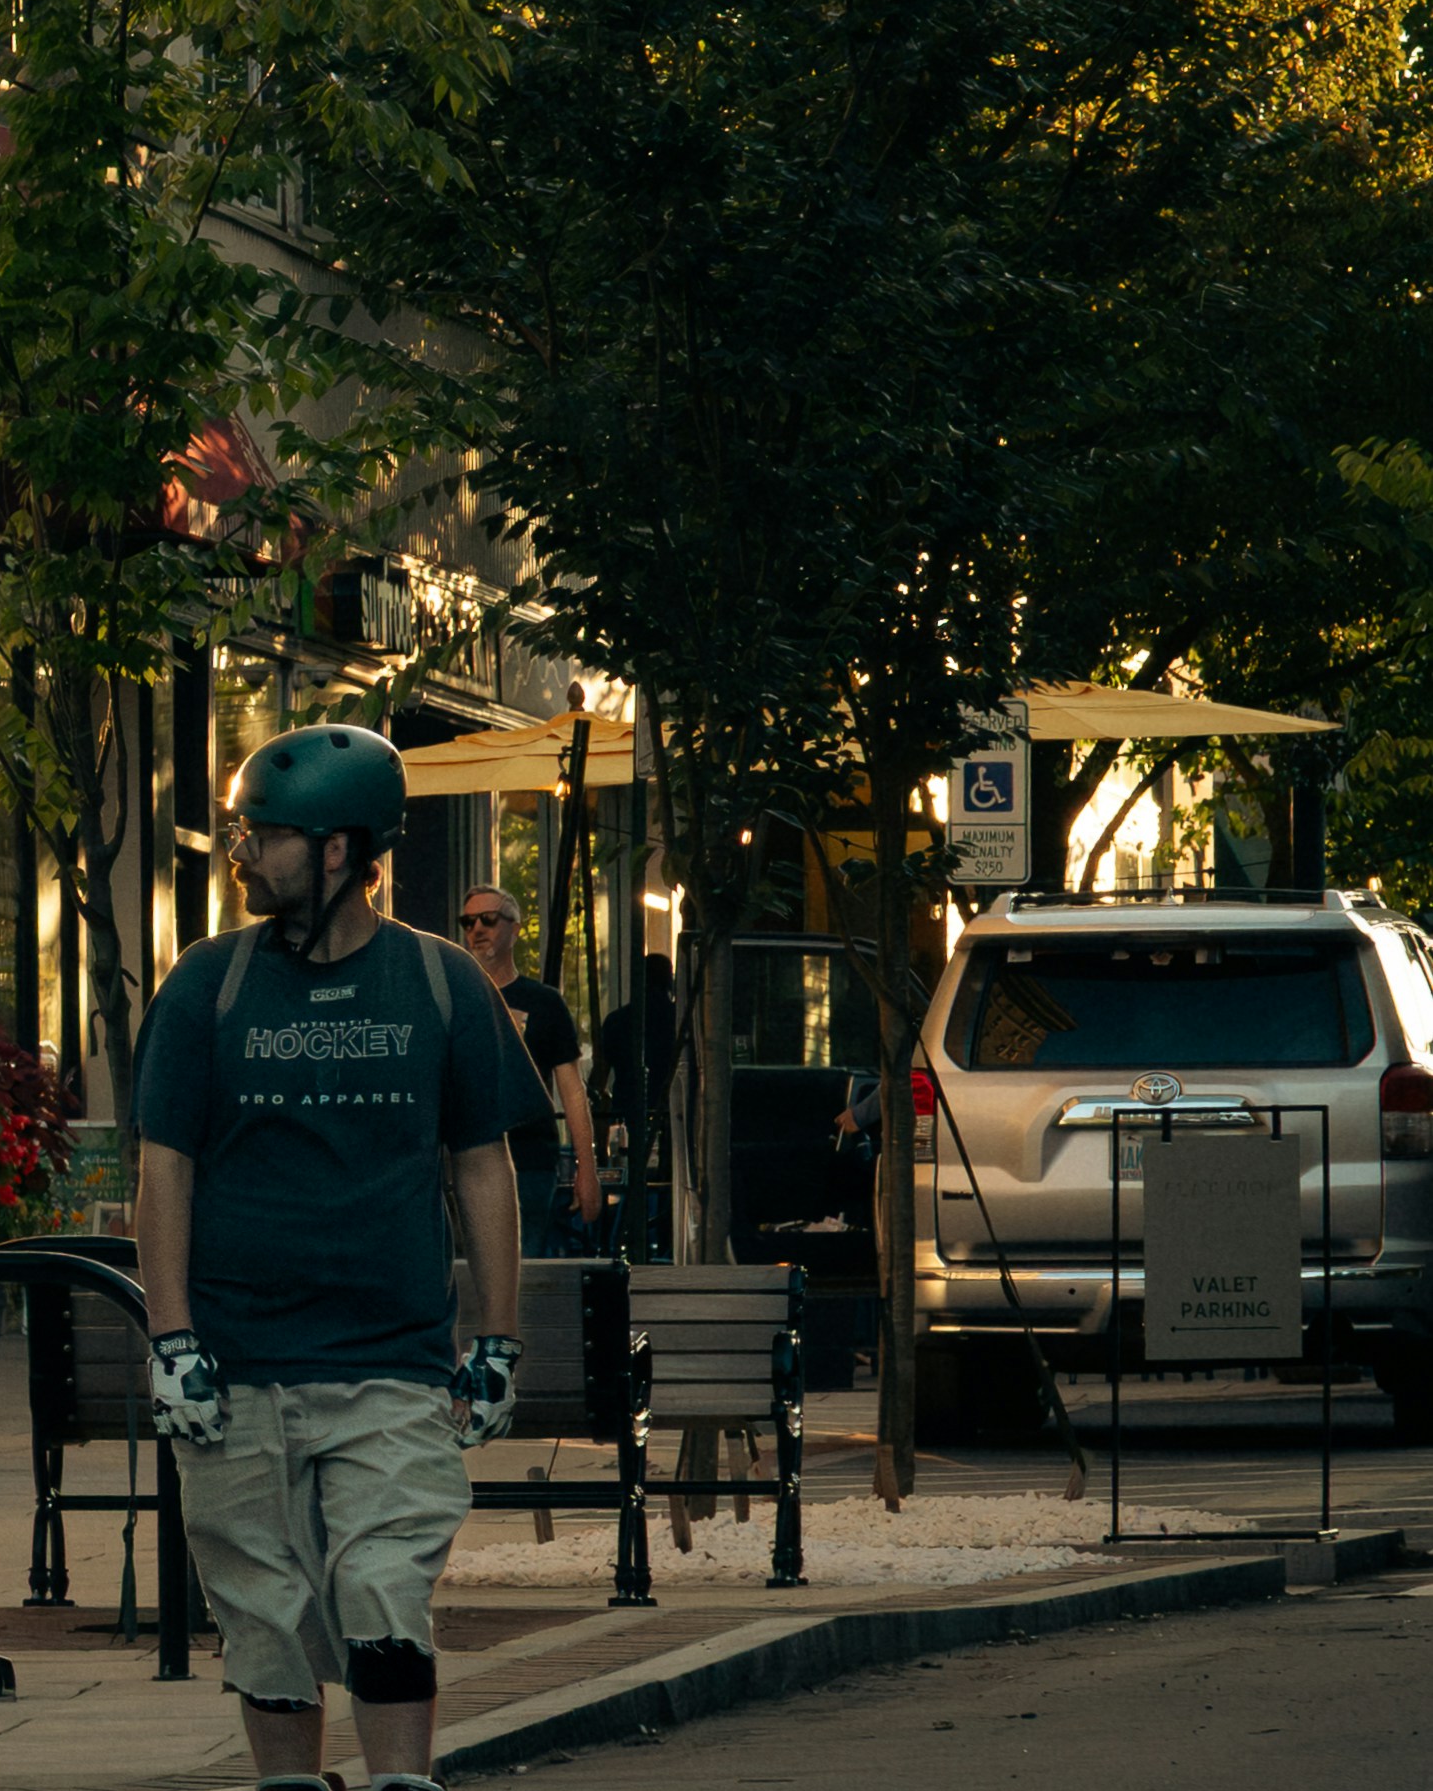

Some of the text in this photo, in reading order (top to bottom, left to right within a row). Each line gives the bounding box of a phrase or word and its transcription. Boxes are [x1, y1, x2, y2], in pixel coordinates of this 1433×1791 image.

[244, 1024, 413, 1060] HOCKEY
[239, 1092, 416, 1106] PRO APPAREL
[1192, 1275, 1259, 1294] VALET
[1181, 1301, 1271, 1319] PARKING
